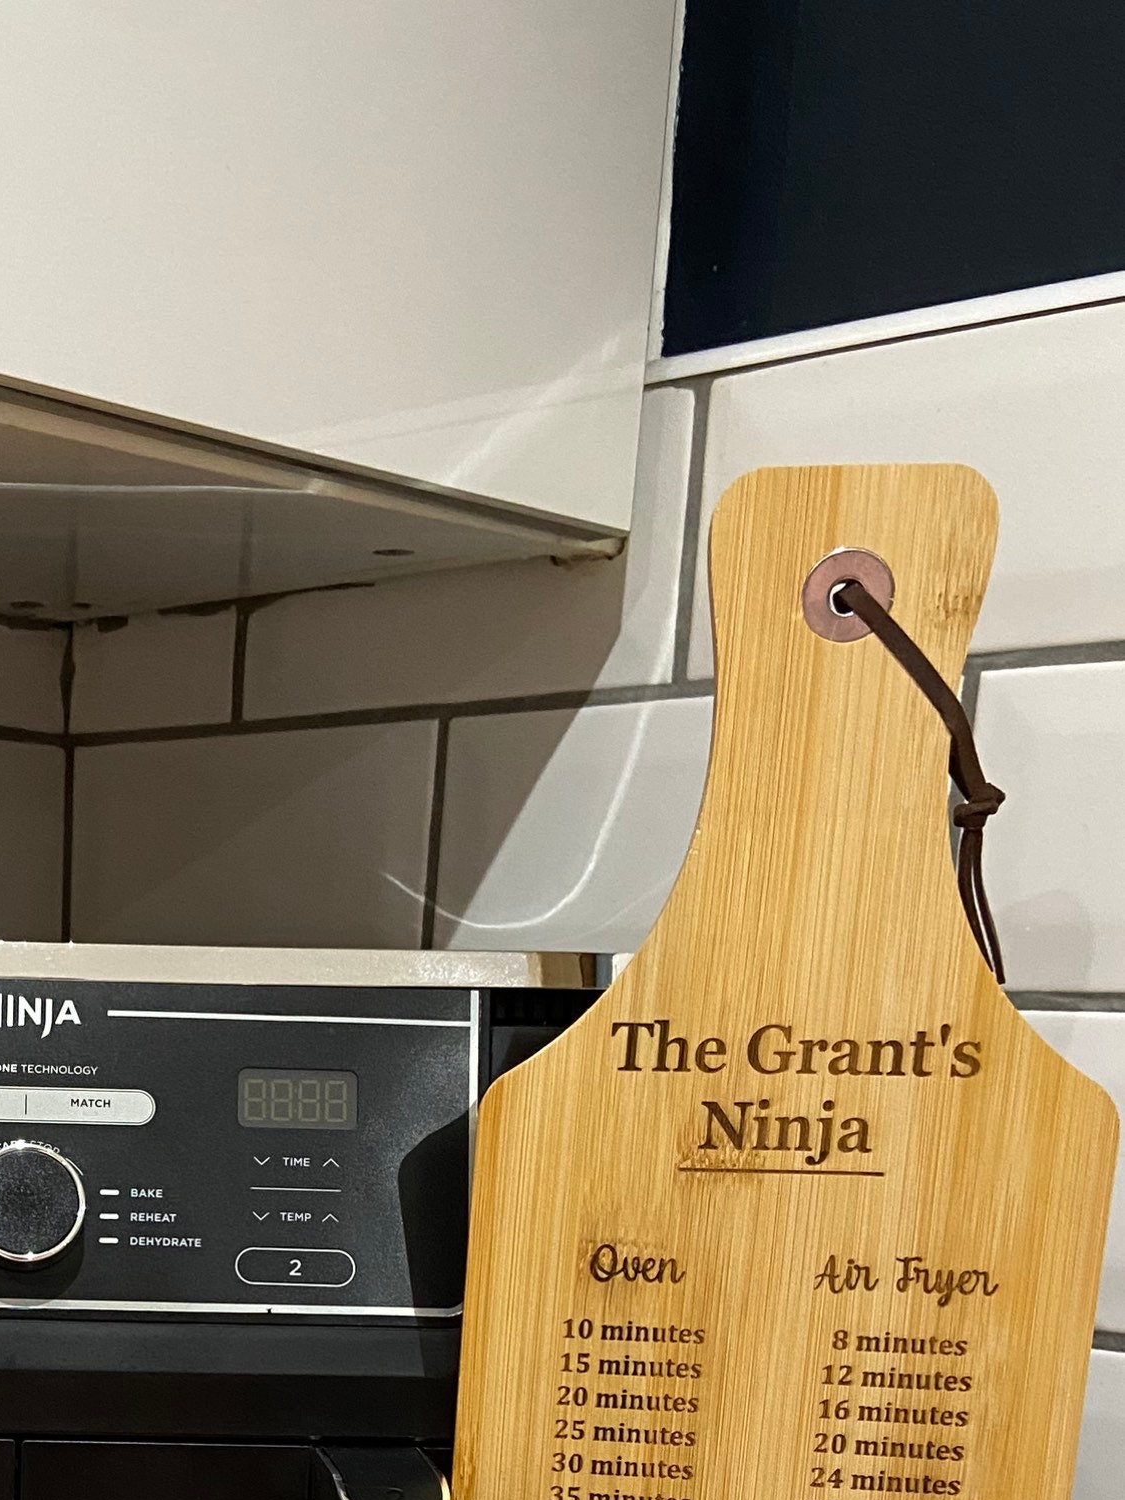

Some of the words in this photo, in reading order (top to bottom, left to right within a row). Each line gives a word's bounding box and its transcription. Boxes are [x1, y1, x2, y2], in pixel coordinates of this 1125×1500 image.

[612, 1020, 727, 1074] The
[747, 1024, 982, 1078] Grant's
[21, 1063, 98, 1076] TECHNOLOGY
[70, 1099, 111, 1108] MATCH
[698, 1099, 872, 1166] Ninja
[283, 1157, 310, 1167] TIME
[130, 1188, 163, 1198] BAKE
[130, 1212, 176, 1222] REHEAT
[280, 1212, 311, 1222] TEMP
[130, 1237, 201, 1248] DEHYDRATE
[289, 1260, 302, 1276] 2
[590, 1244, 685, 1284] Oven
[814, 1255, 879, 1294] Air
[896, 1257, 999, 1307] Fryer
[563, 1318, 593, 1340] 10
[601, 1320, 705, 1344] minutes
[832, 1330, 849, 1351] 8
[855, 1331, 968, 1356] minutes
[560, 1353, 590, 1373] 15
[598, 1355, 702, 1379] minutes
[821, 1365, 852, 1386] 12
[861, 1367, 972, 1392] minutes
[557, 1386, 588, 1407] 20
[596, 1389, 699, 1413] minutes
[819, 1400, 849, 1420] 16
[858, 1402, 969, 1427] minutes
[555, 1419, 585, 1440] 25
[593, 1422, 696, 1447] minutes
[813, 1434, 846, 1454] 20
[854, 1436, 965, 1461] minutes
[552, 1453, 583, 1473] 30
[590, 1456, 693, 1480] minutes
[810, 1468, 844, 1489] 24
[850, 1470, 961, 1496] minutes
